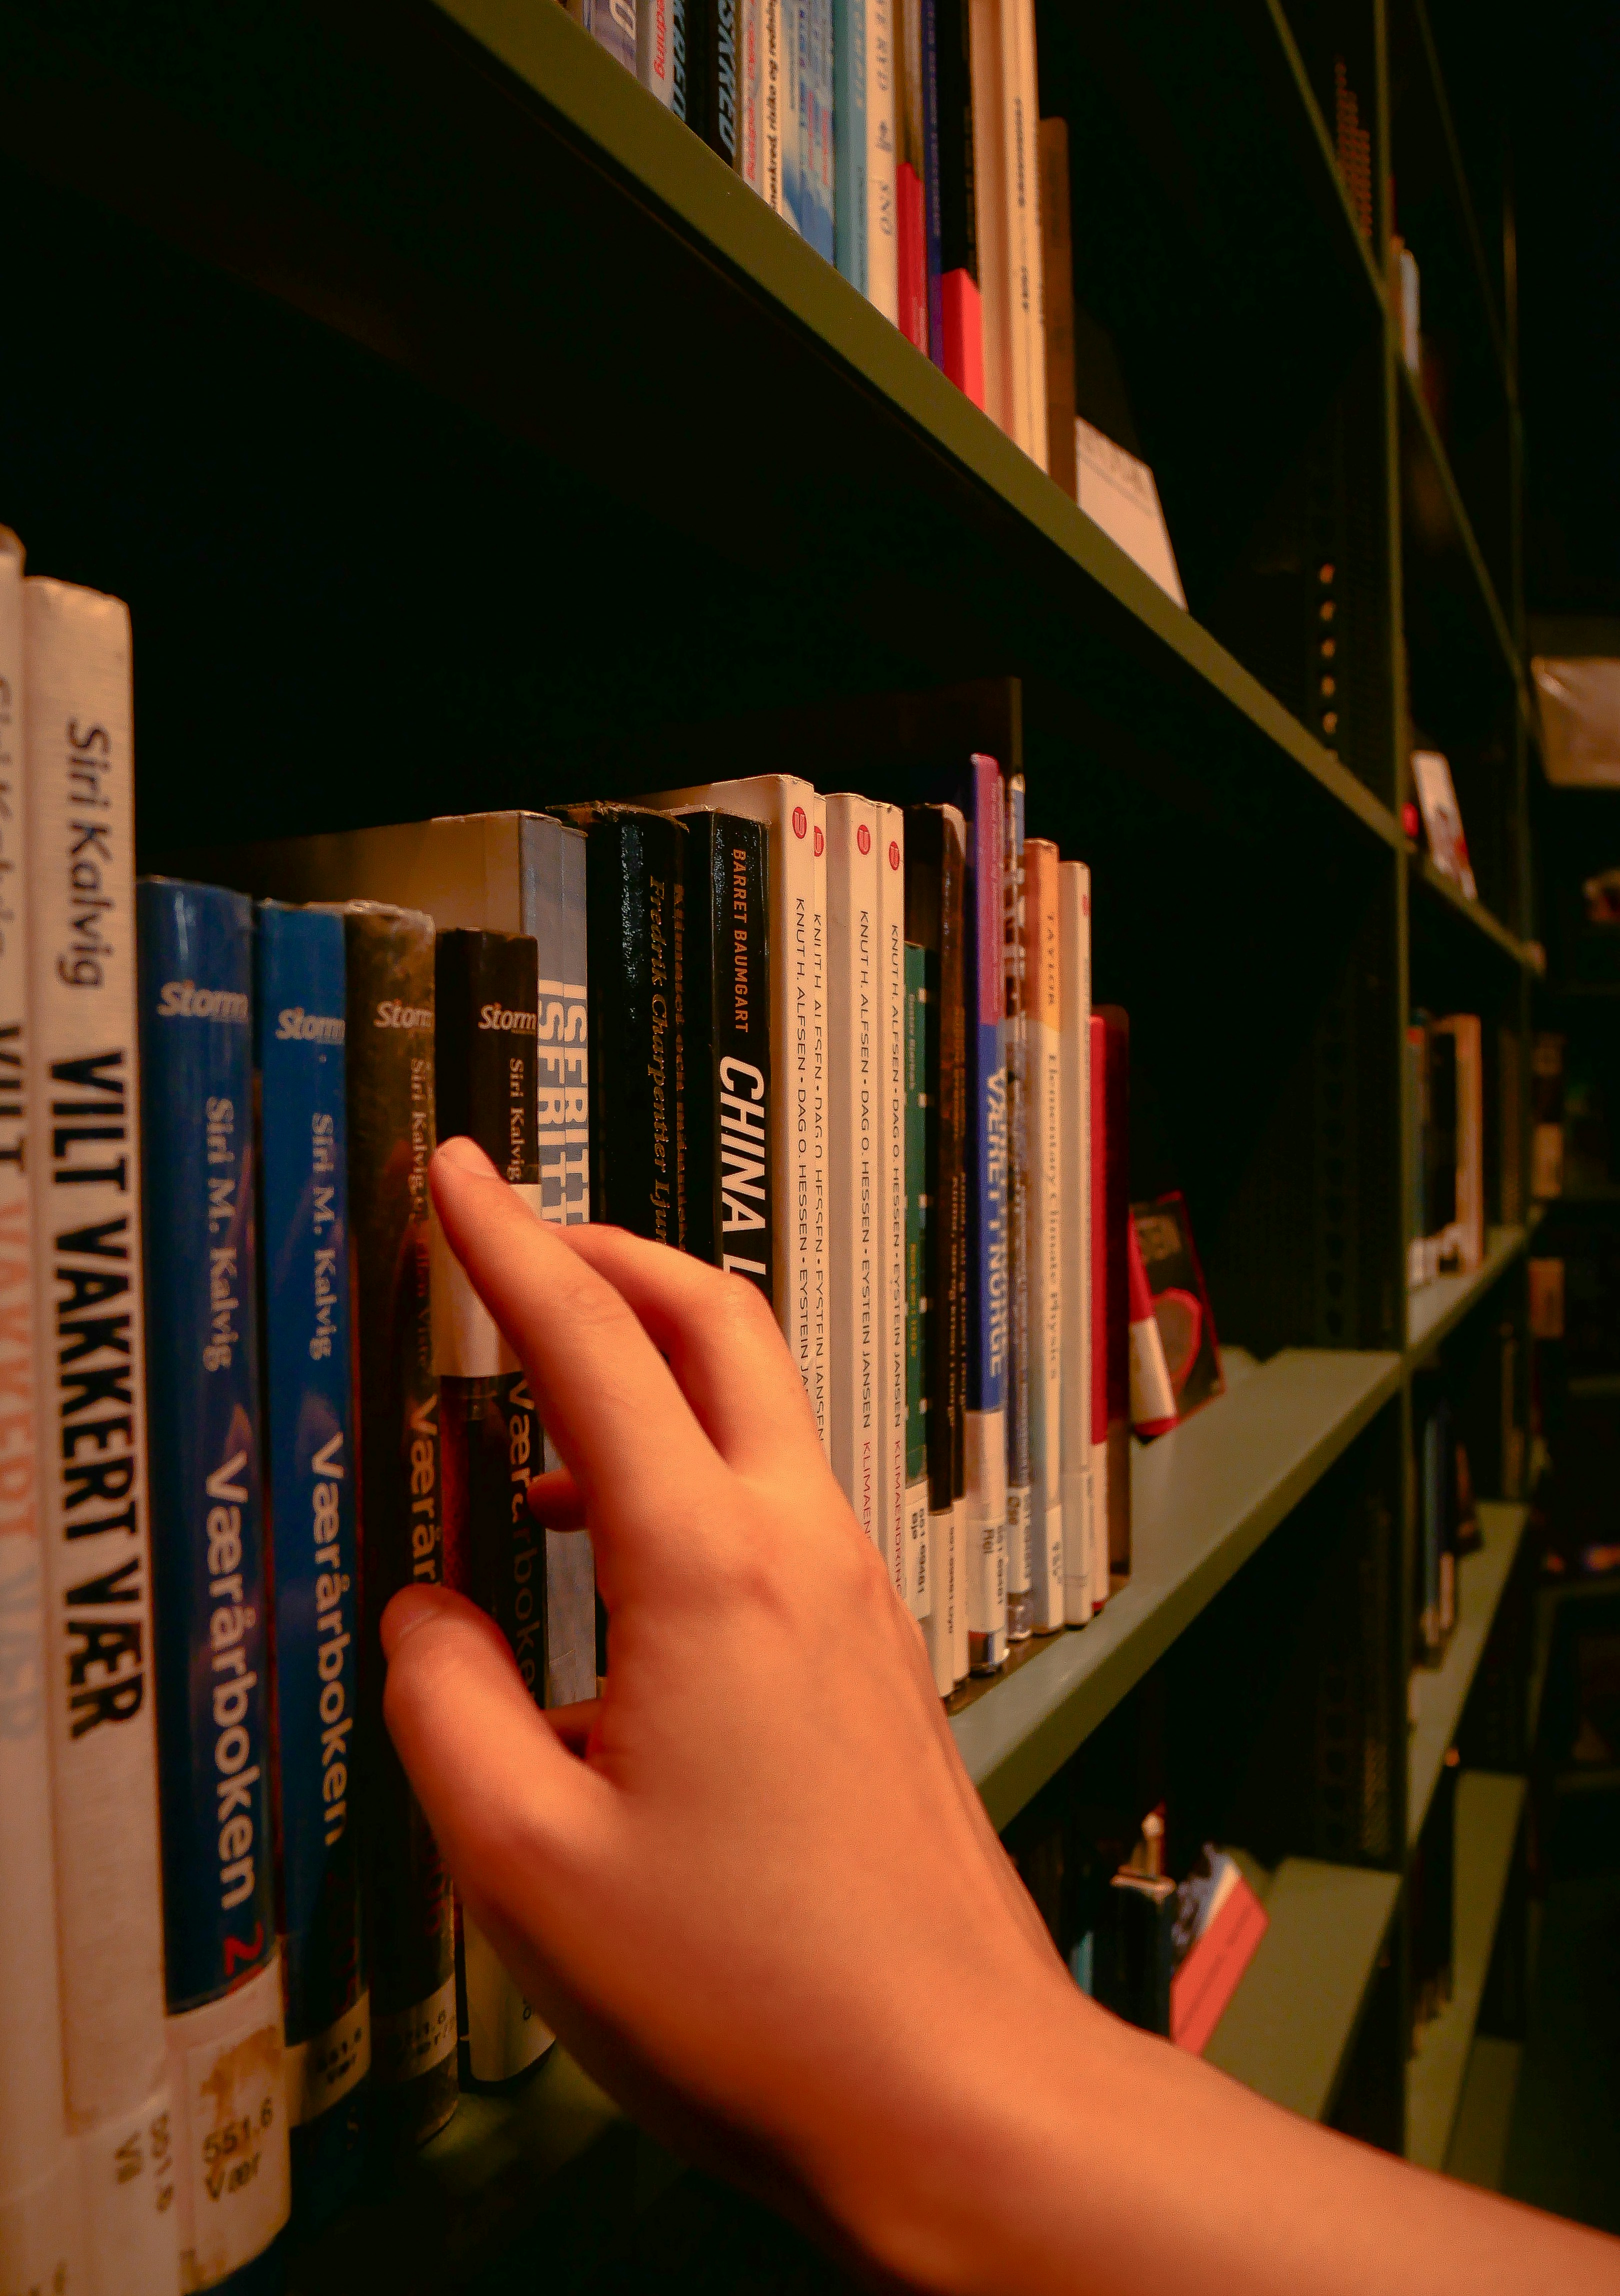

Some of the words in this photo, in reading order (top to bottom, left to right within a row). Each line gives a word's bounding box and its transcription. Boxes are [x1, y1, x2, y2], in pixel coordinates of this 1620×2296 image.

[68, 716, 112, 806] Siri
[56, 821, 113, 990] Kalvig
[732, 848, 747, 924] BARRET
[796, 898, 805, 958] KNUT
[650, 874, 668, 987] Fredrik
[860, 910, 868, 968] KNUT
[478, 1002, 537, 1031] Storm
[734, 931, 749, 1033] BAUMGART
[797, 986, 806, 1071] ALFSEN
[860, 994, 870, 1073] ALFSEN
[510, 1058, 524, 1098] Siri
[648, 993, 669, 1173] Charpentier
[798, 1089, 807, 1132] DAG
[861, 1090, 870, 1132] DAG
[51, 1049, 128, 1195] VILT
[206, 1096, 234, 1164] Siri
[311, 1112, 334, 1174] Siri
[408, 1111, 432, 1193] Kalvig
[508, 1107, 525, 1182] Kalvig
[719, 1056, 766, 1233] CHINA
[798, 1139, 807, 1159] O.
[208, 1177, 236, 1234] M.
[313, 1186, 336, 1236] M.
[651, 1179, 670, 1245] Ljun
[798, 1165, 808, 1252] HESSEN
[861, 1160, 870, 1243] HESSEN
[202, 1248, 239, 1372] Kalvig
[308, 1247, 338, 1360] Kalvig
[799, 1269, 809, 1360] EYSTEIN
[862, 1260, 870, 1345] EYSTEIN
[56, 1214, 138, 1542] VAKKERT
[862, 1351, 871, 1428] JANSEN
[410, 1393, 442, 1585] Værår
[862, 1441, 872, 1538] KLIMAEN
[508, 1378, 542, 1706] Værrboke
[66, 1554, 145, 1741] VÆR
[206, 1450, 261, 1910] Værårboken
[310, 1431, 352, 1846] Værårboken
